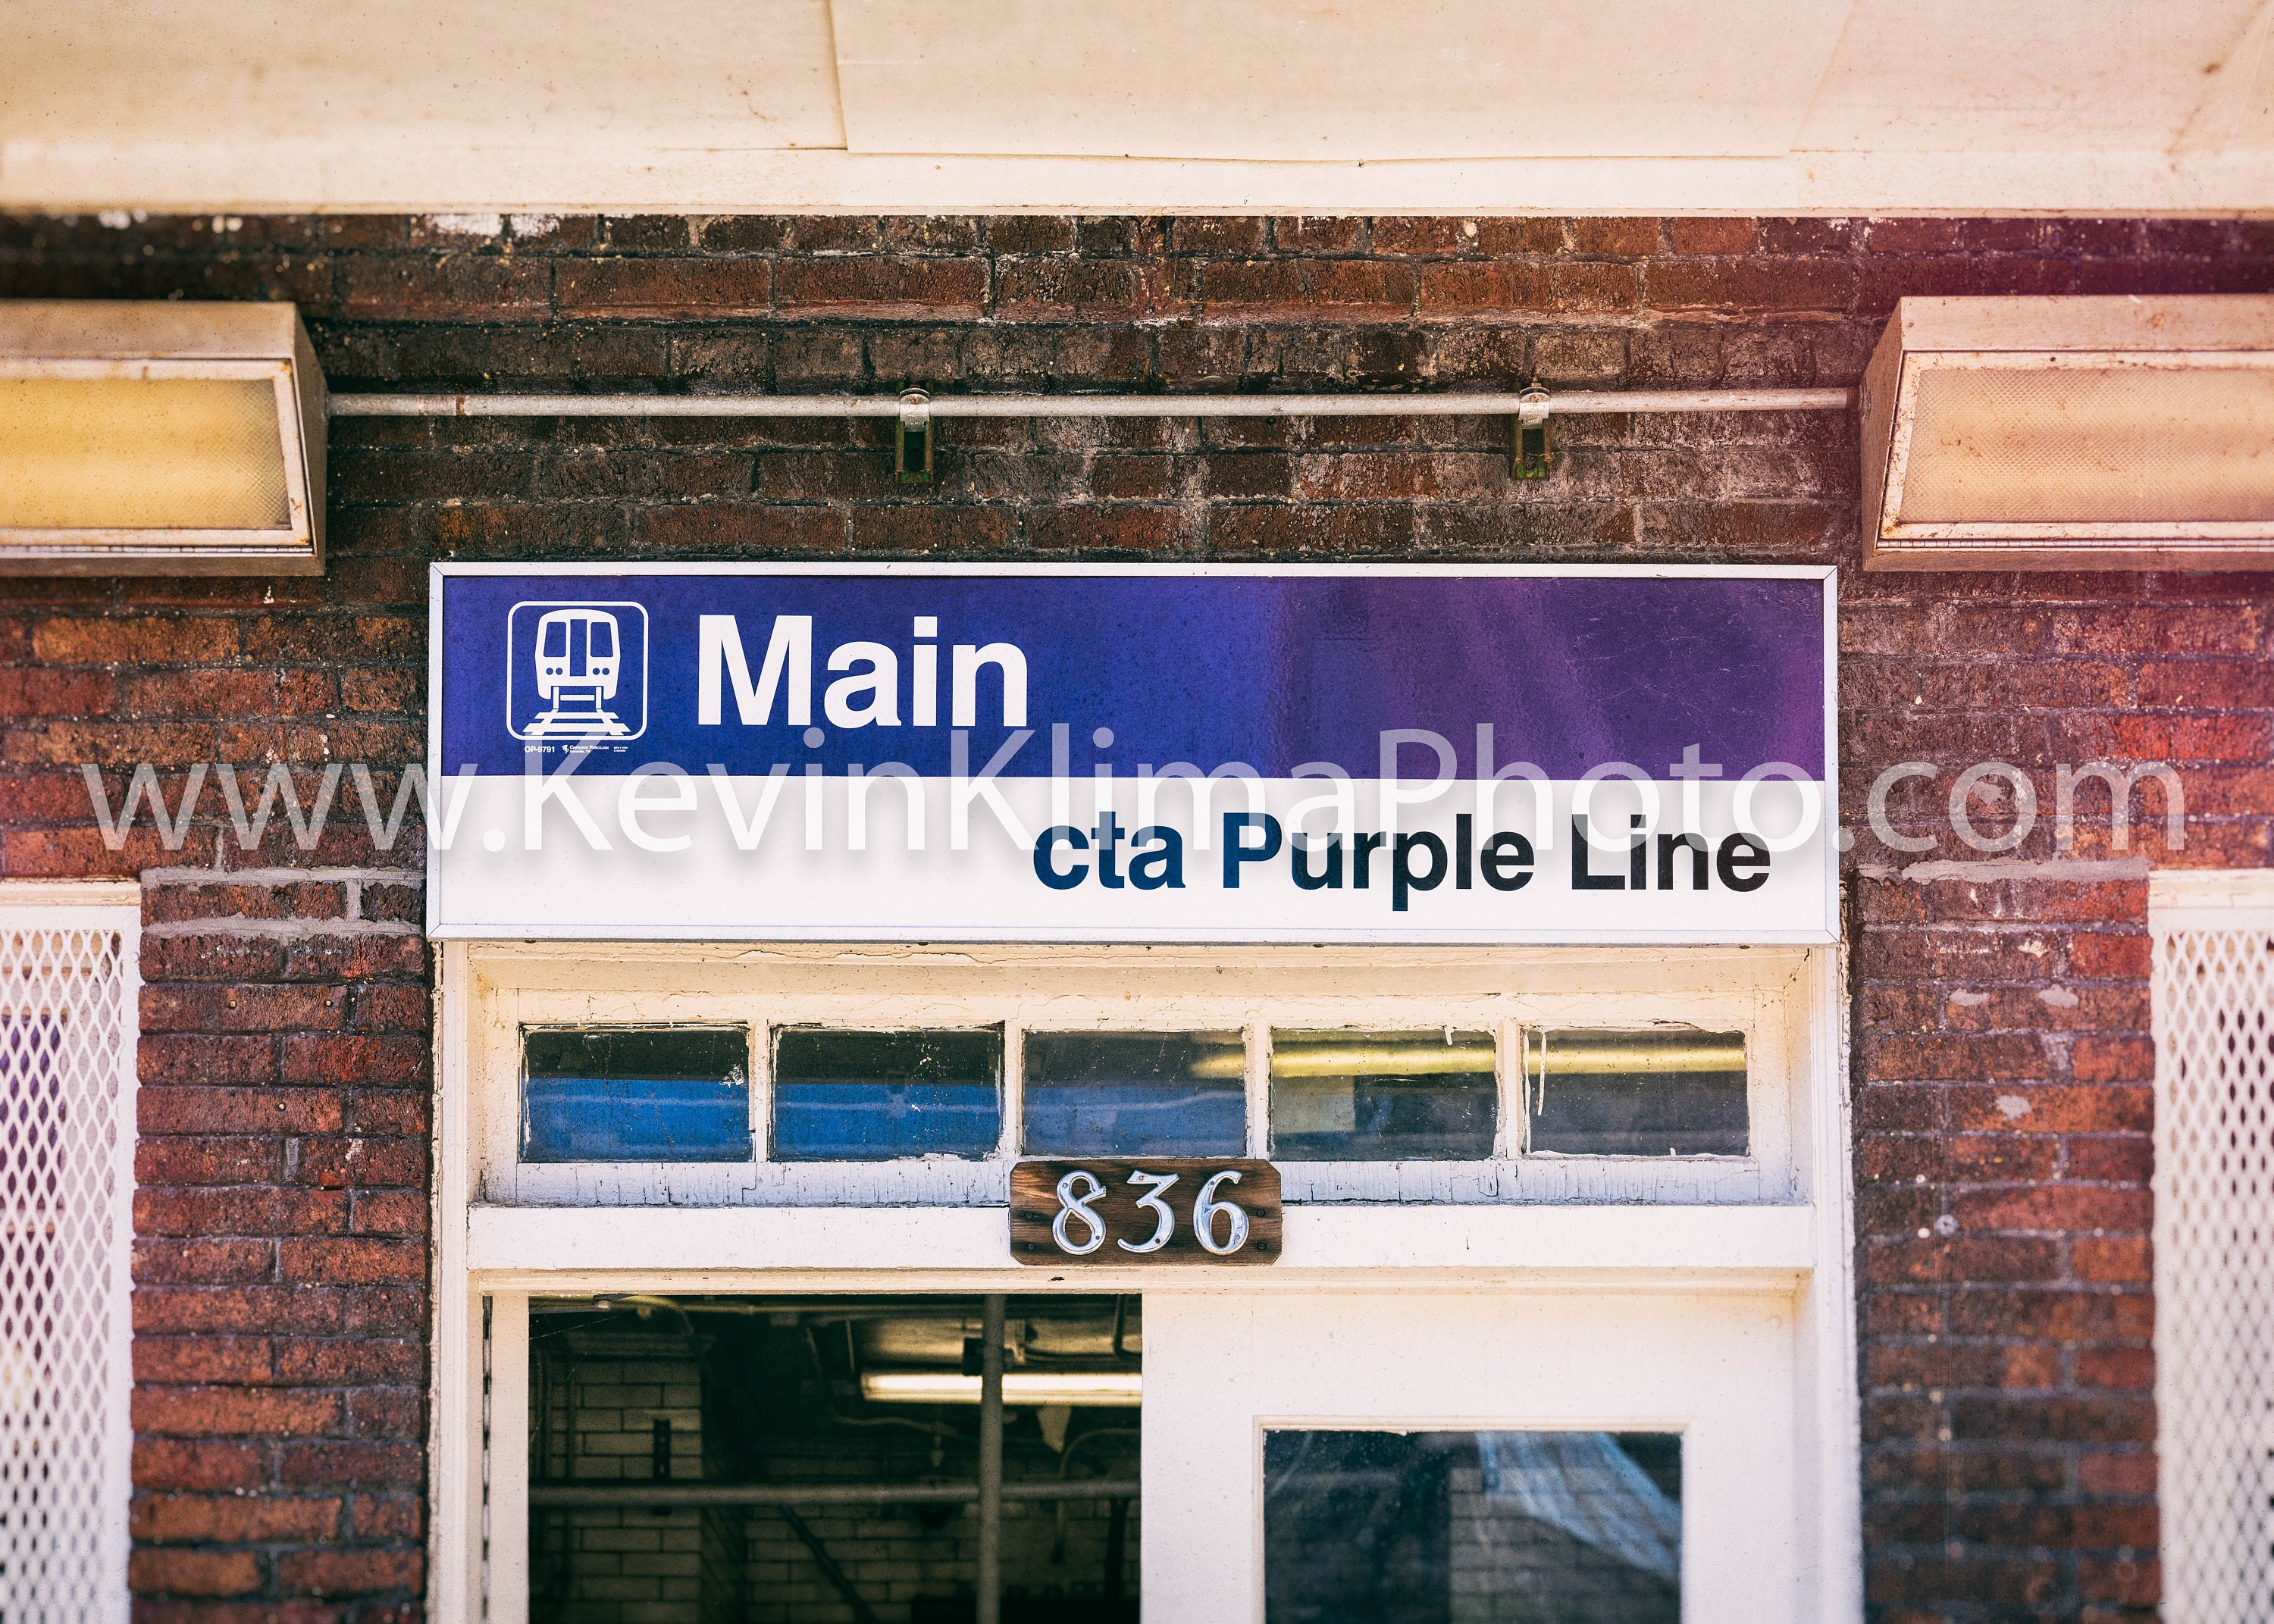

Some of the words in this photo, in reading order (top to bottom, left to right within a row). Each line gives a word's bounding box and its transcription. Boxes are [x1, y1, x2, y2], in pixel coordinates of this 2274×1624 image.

[697, 615, 1027, 728] Main
[1033, 811, 1186, 891] cta
[1223, 813, 1534, 911] Purple
[1571, 813, 1771, 891] Line
[1053, 1170, 1250, 1255] 836
